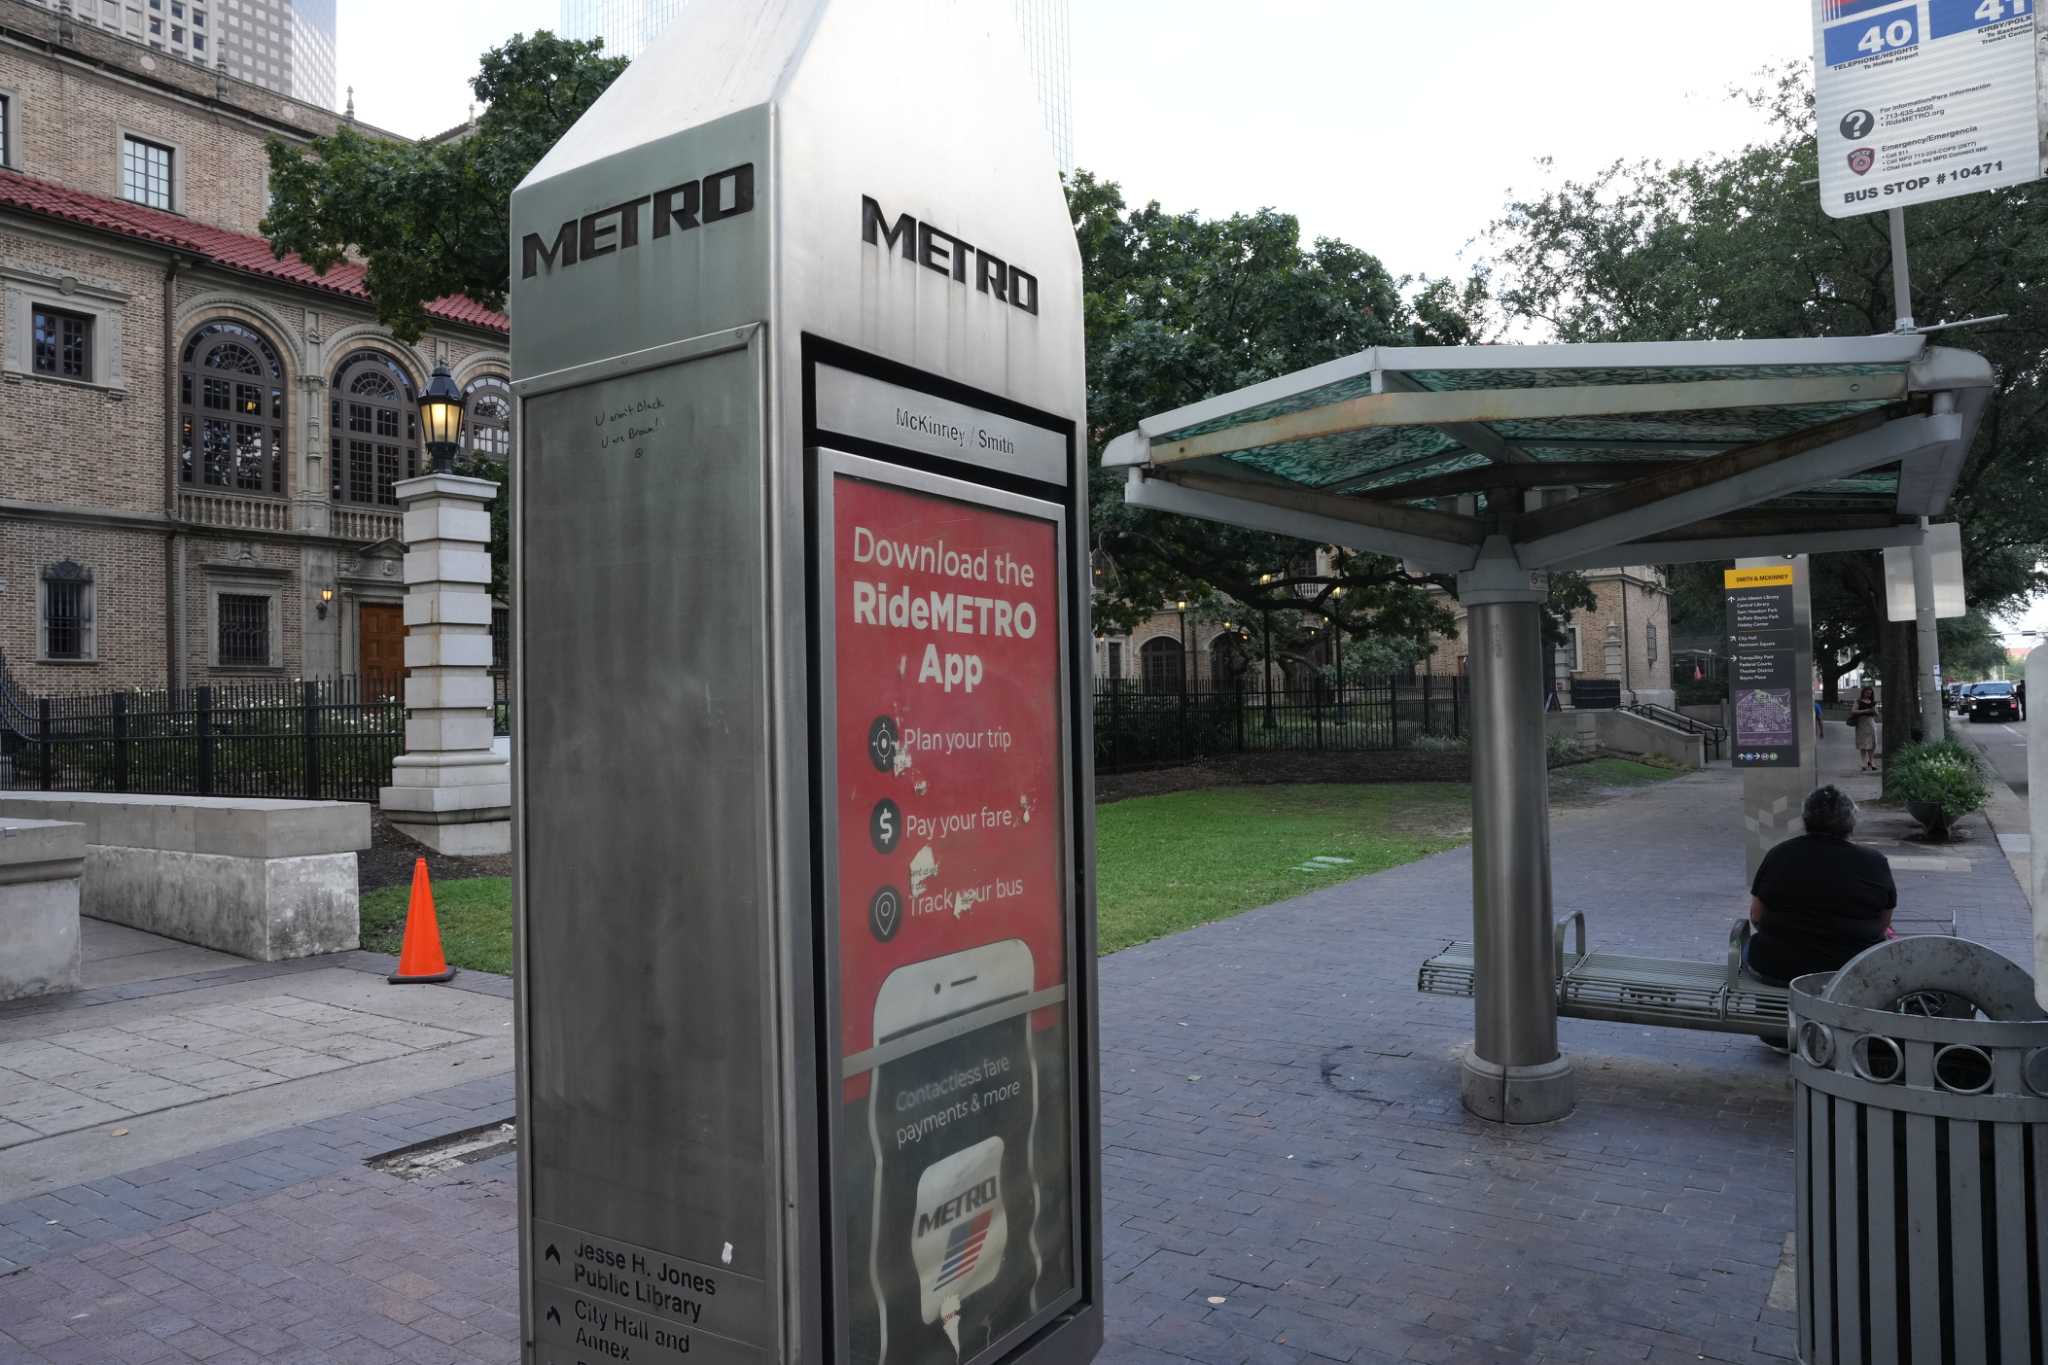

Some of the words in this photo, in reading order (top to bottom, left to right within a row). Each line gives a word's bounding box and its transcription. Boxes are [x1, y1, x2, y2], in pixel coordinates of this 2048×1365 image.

[1833, 45, 1919, 70] TELEPHONE/HEIGHTS
[1857, 19, 1912, 53] 40
[1895, 52, 1919, 63] Airport
[1881, 126, 1978, 152] Emergency/Emergencia
[1885, 109, 1945, 127] RideMETRO.org
[1843, 188, 1878, 203] BUS
[1883, 177, 1930, 195] STOP
[522, 163, 754, 280] METRO
[862, 194, 1038, 315] METRO
[896, 408, 965, 447] McKinney
[853, 526, 988, 582] Download
[995, 553, 1034, 587] the
[853, 580, 1037, 639] RideMETRO
[918, 643, 983, 693] App
[904, 728, 942, 751] Plan
[945, 732, 985, 755] your
[987, 725, 1012, 753] trip
[906, 815, 937, 840] Pay
[940, 812, 977, 838] your
[981, 806, 1012, 828] fare
[908, 887, 953, 917] Track
[996, 878, 1023, 898] bus
[895, 1067, 981, 1111] Contactless
[983, 1056, 1010, 1079] fare
[896, 1101, 968, 1150] payments
[970, 1093, 980, 1112] &
[983, 1081, 1020, 1107] more
[917, 1176, 997, 1238] METRO
[573, 1241, 626, 1270] Jesse
[632, 1254, 651, 1277] H.
[657, 1262, 716, 1295] Jones
[574, 1264, 629, 1298] Public
[636, 1280, 702, 1324] Library
[575, 1299, 608, 1332] City
[614, 1312, 649, 1341] Hall
[656, 1330, 690, 1353] and
[576, 1327, 630, 1361] Annex
